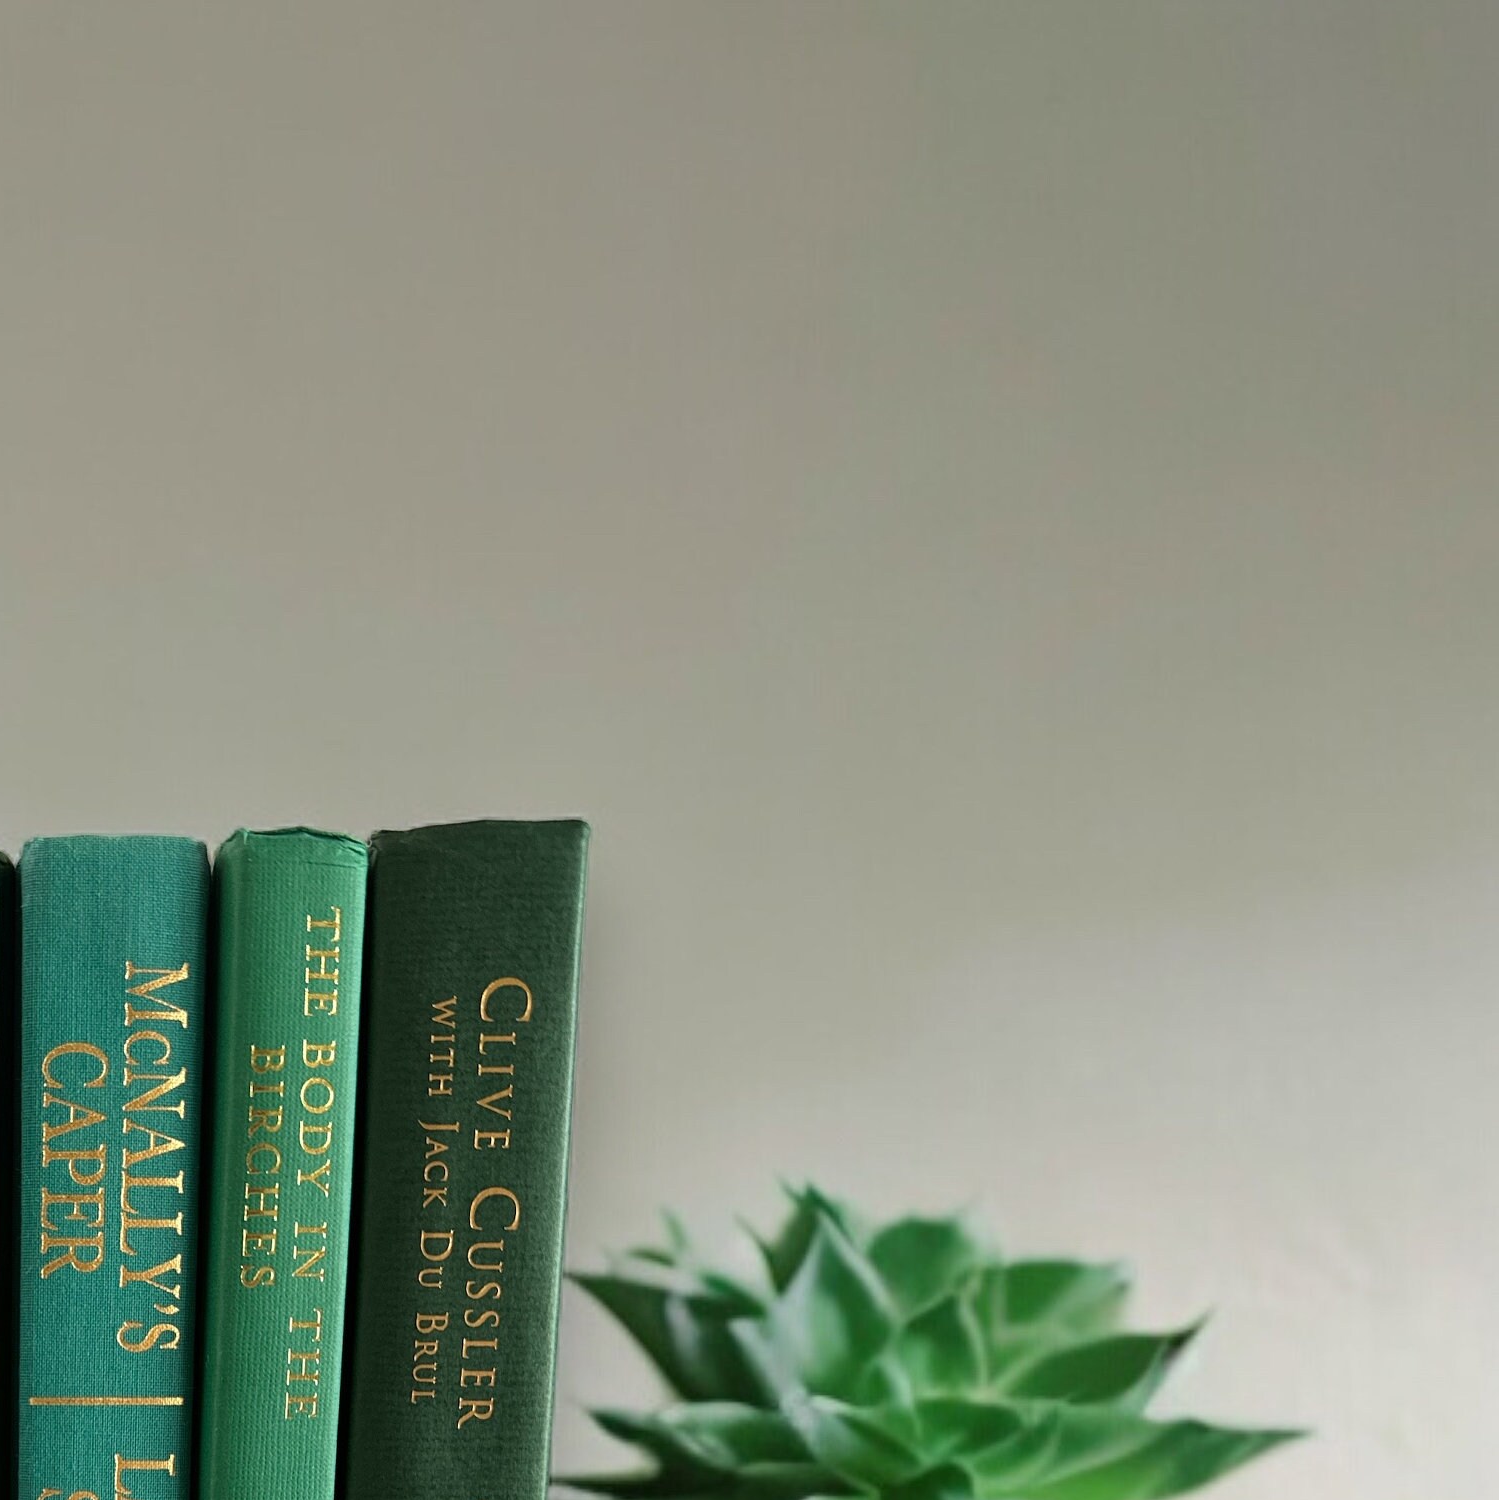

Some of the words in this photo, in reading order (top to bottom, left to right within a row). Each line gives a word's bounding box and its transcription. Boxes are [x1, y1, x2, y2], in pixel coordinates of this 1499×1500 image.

[304, 906, 341, 1017] THE
[428, 995, 458, 1097] WITH
[473, 976, 533, 1151] CLIVE
[41, 1042, 110, 1279] CAPER
[116, 961, 190, 1353] McNALLY'S
[240, 1044, 286, 1288] BIRCHES
[297, 1039, 336, 1197] BODY
[418, 1119, 460, 1208] JACK
[291, 1221, 328, 1283] IN
[417, 1229, 455, 1289] DU
[457, 1186, 521, 1430] CUSSLER
[285, 1307, 324, 1420] THE
[410, 1312, 449, 1405] BRUL
